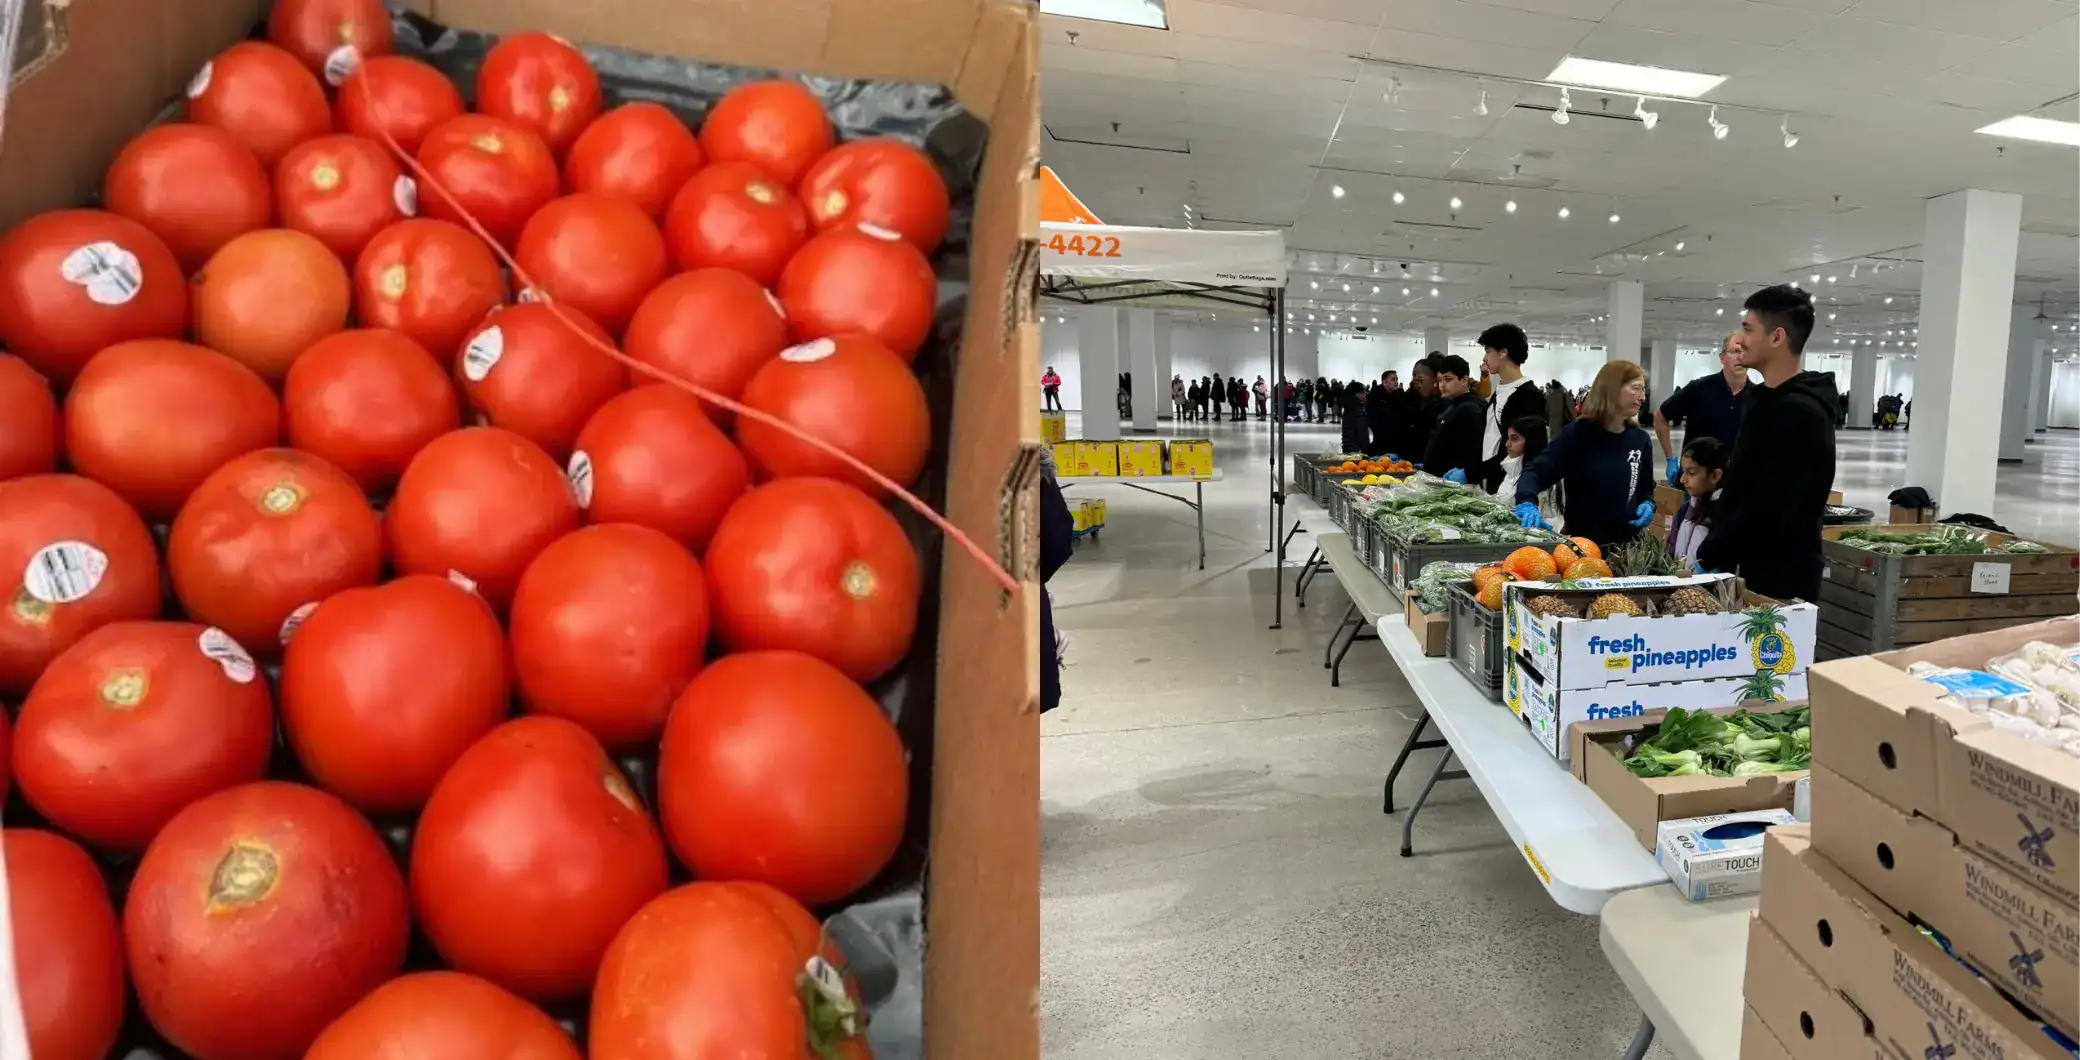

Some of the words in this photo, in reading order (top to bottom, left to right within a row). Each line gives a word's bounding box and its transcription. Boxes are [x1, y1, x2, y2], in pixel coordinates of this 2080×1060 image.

[1588, 633, 1645, 654] fresh
[1632, 643, 1737, 673] pineapples
[1587, 701, 1644, 720] fresh
[1968, 750, 2041, 797] WINDMILL
[1725, 857, 1760, 871] TOUCH
[1966, 863, 2040, 923] WINDMILL
[1894, 948, 1954, 1019] WINDMILL
